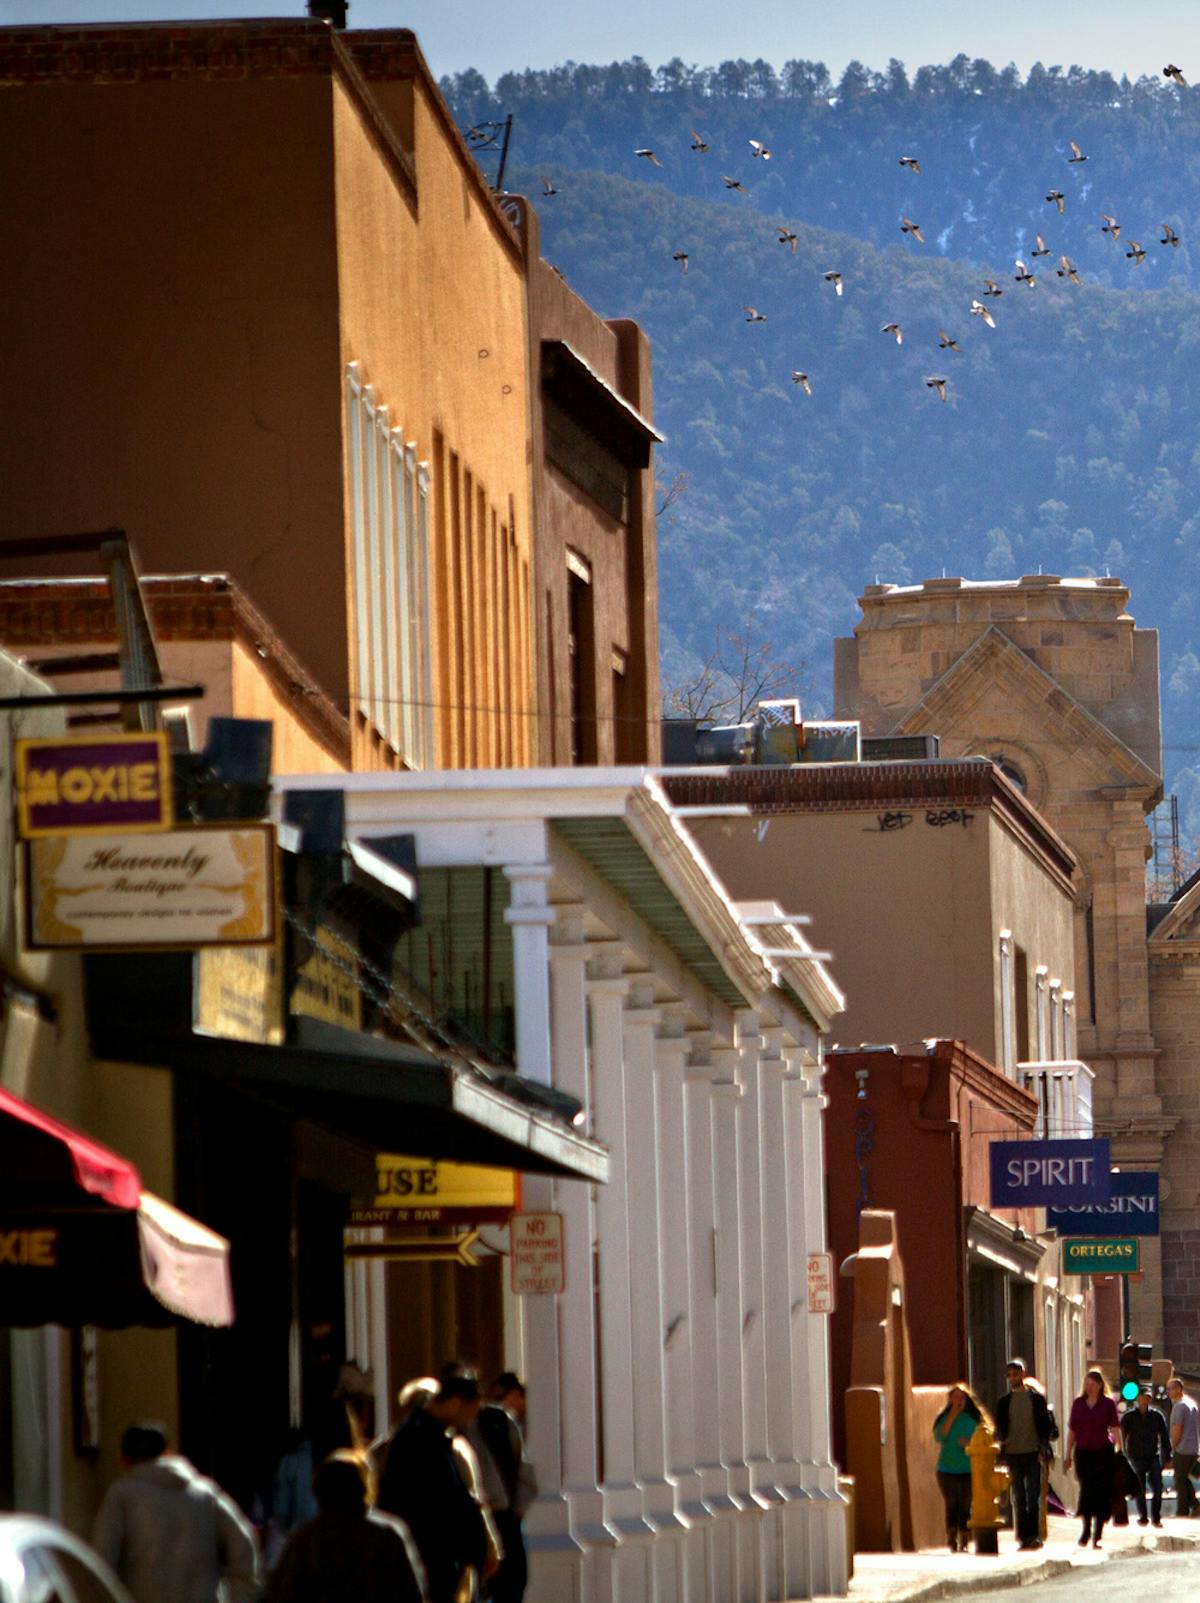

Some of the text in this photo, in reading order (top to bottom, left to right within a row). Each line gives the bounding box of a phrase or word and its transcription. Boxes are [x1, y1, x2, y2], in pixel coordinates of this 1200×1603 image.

[26, 763, 157, 805] MOXIE
[83, 847, 210, 878] Heavenly
[106, 878, 187, 897] Boutique
[1007, 1157, 1094, 1187] SPIRIT
[414, 1209, 439, 1221] BAR
[527, 1219, 545, 1236] NO
[1069, 1245, 1133, 1257] ORTEGA'S
